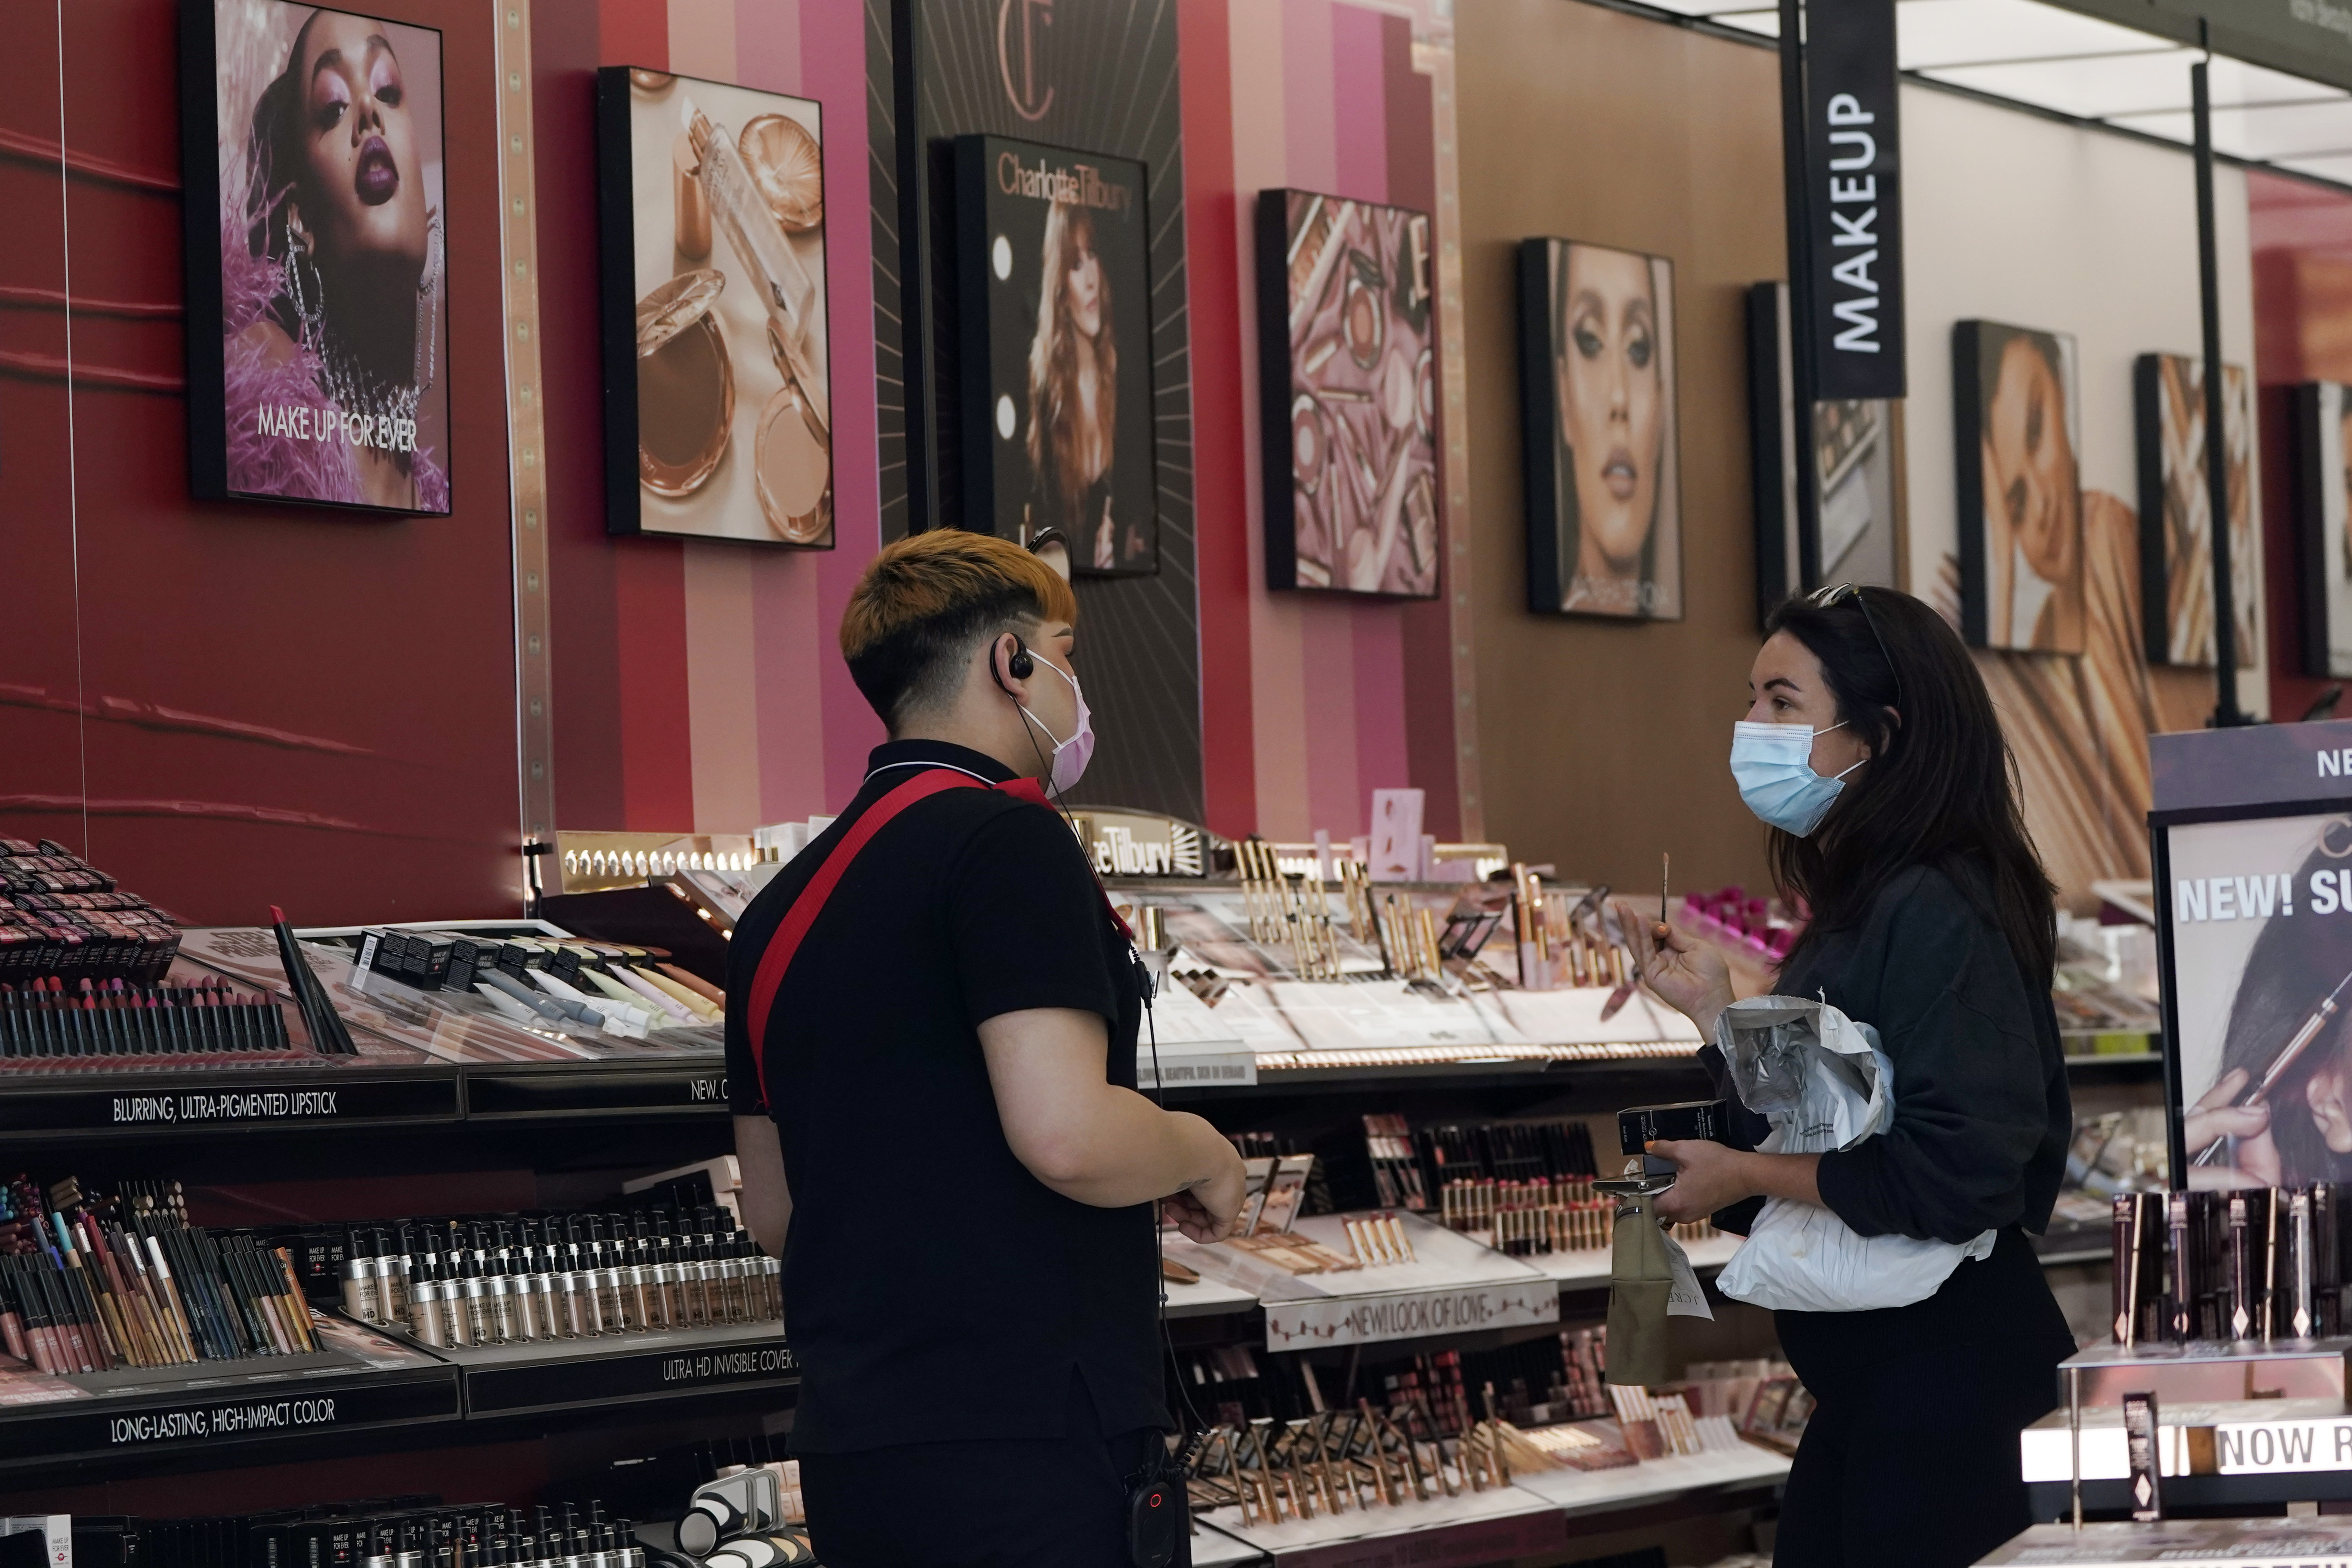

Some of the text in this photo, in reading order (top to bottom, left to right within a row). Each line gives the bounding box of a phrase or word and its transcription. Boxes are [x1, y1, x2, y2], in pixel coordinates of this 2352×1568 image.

[998, 152, 1132, 222] Charlotte Tilbury
[1827, 92, 1881, 354] MAKEUP
[258, 401, 417, 452] MAKE UP FOR EVER
[1102, 827, 1171, 874] Tilbury
[2177, 873, 2293, 922] NEW!
[114, 1091, 337, 1124] BLURRING, ULTRA-PIGMENTED LIPSTICK
[691, 1079, 718, 1100] NEW.
[1392, 1300, 1429, 1332] LOOK
[1432, 1298, 1450, 1327] OF
[1454, 1294, 1488, 1326] LOVE
[1669, 1292, 1699, 1306] J.CRE
[664, 1359, 693, 1381] ULTRA
[696, 1356, 711, 1377] HD
[714, 1352, 757, 1376] INVISIBLE
[111, 1398, 335, 1443] LONG-LASTING, HIGH-IMPACT COLOR
[2219, 1427, 2314, 1466] NOW
